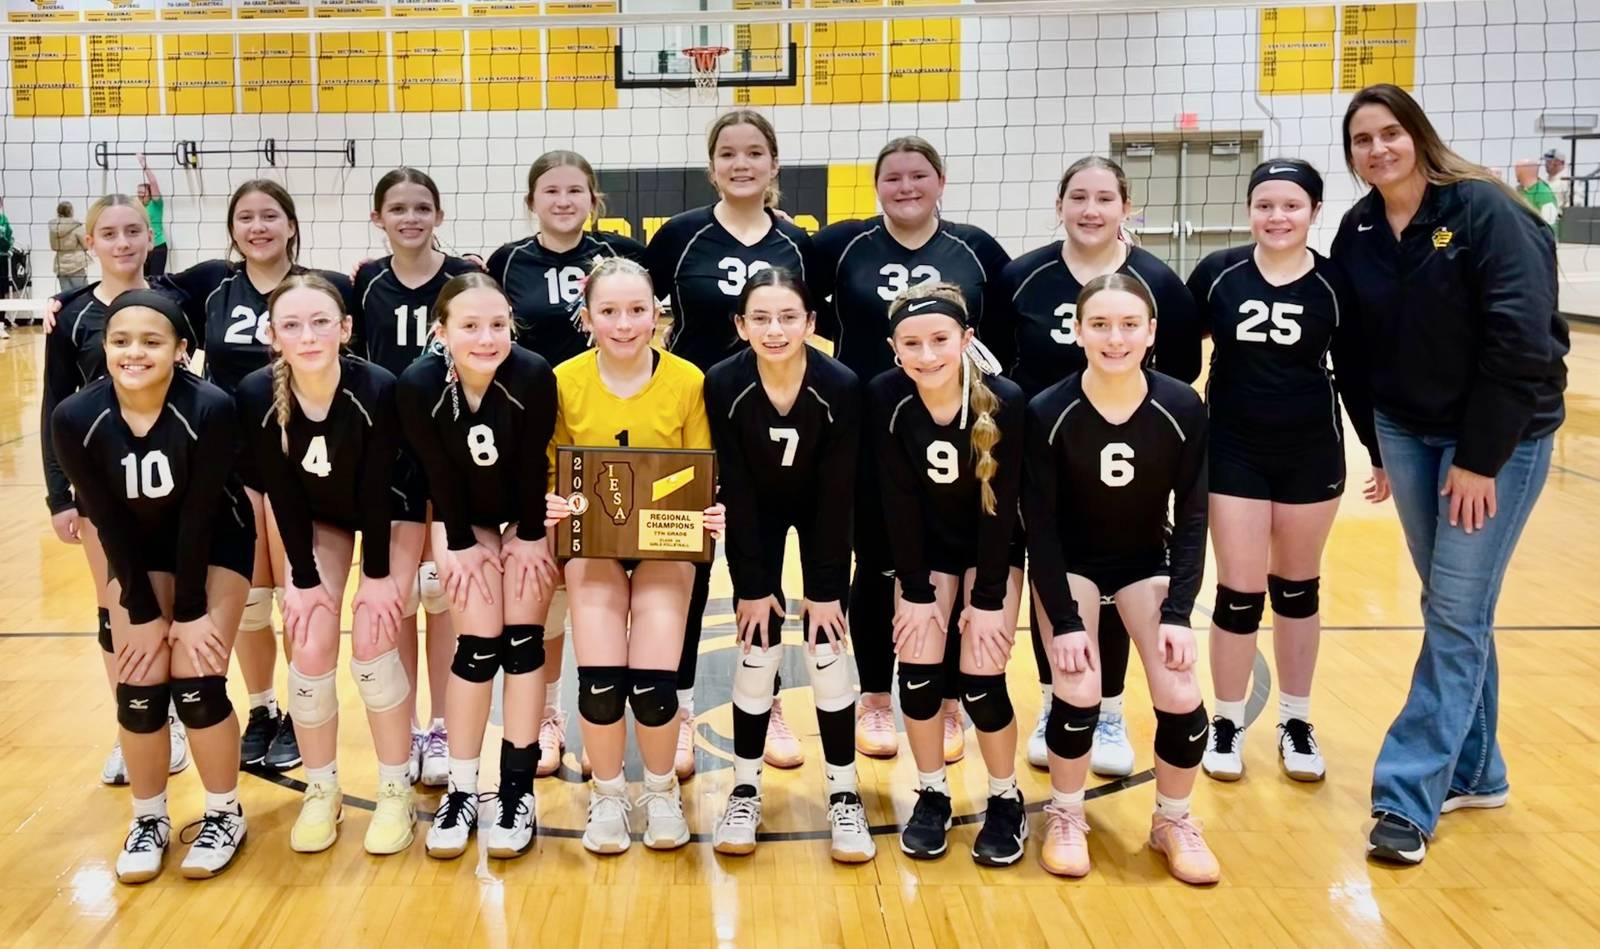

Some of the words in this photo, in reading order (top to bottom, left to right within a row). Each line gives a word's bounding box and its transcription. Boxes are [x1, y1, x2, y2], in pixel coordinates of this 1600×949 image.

[544, 266, 587, 305] 16
[718, 257, 772, 296] 3
[394, 304, 428, 347] 11
[1236, 299, 1304, 346] 25
[301, 435, 332, 477] 4
[467, 423, 499, 467] 8
[769, 427, 800, 466] 7
[926, 440, 960, 484] 9
[1100, 442, 1135, 487] 6
[121, 449, 174, 499] 10
[608, 464, 626, 520] IESA
[646, 522, 694, 530] CHAMPIONS
